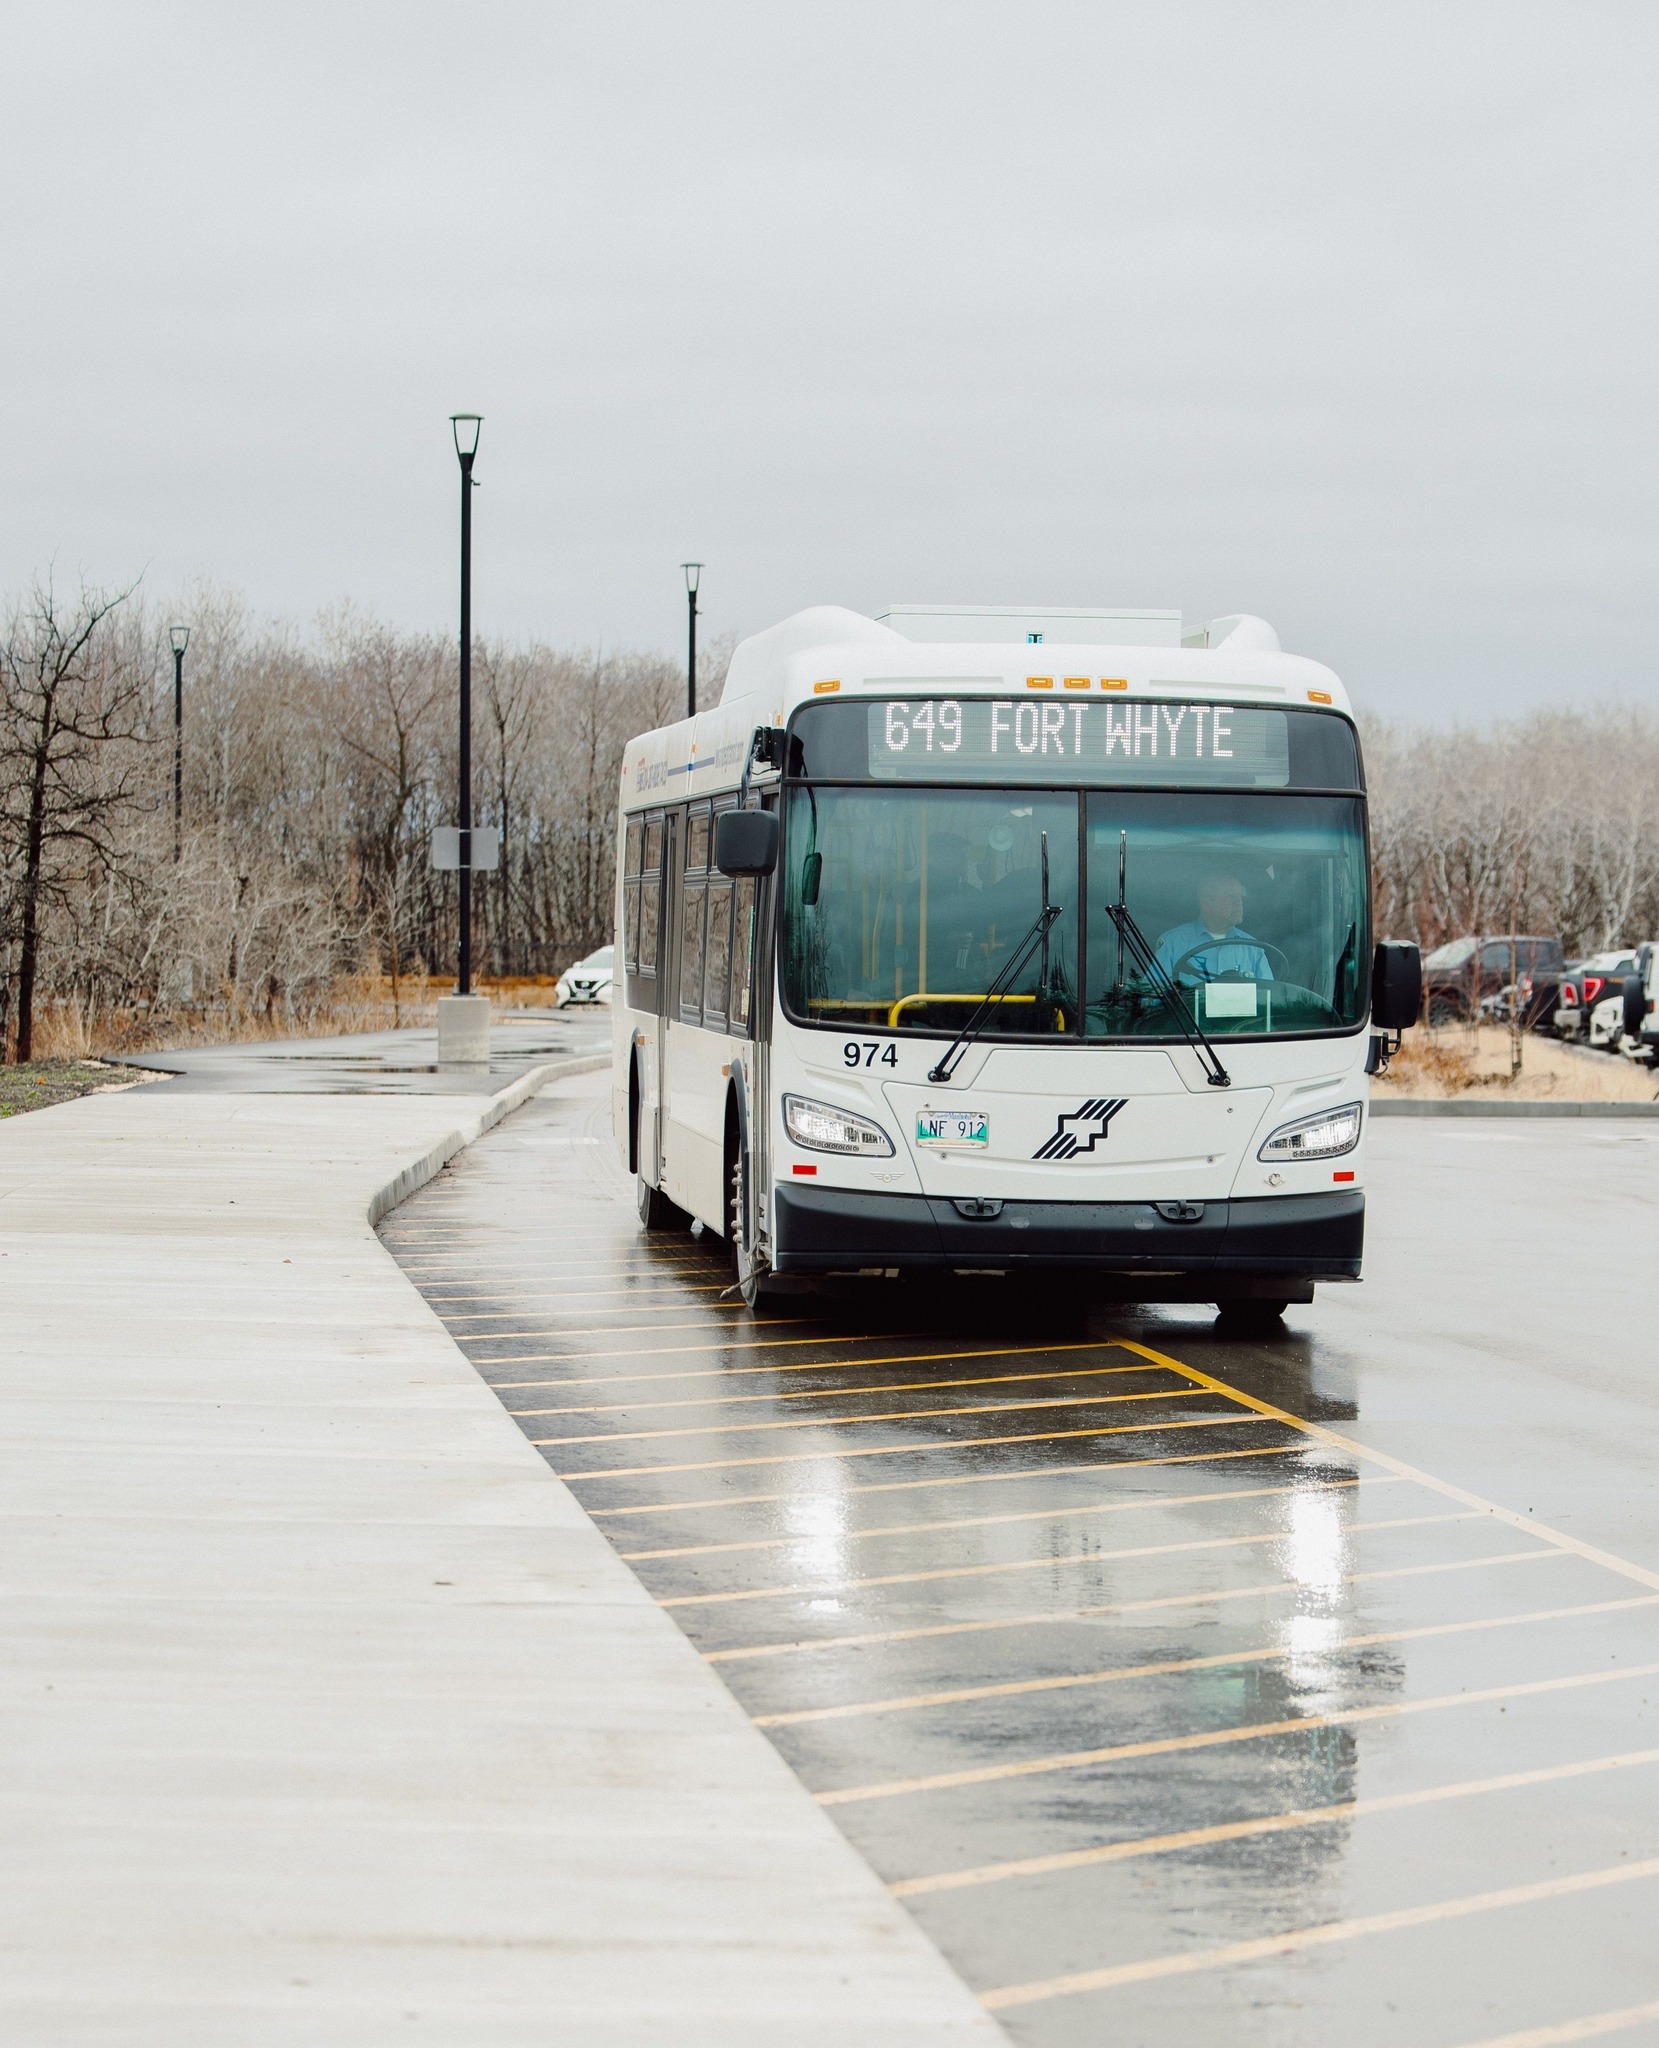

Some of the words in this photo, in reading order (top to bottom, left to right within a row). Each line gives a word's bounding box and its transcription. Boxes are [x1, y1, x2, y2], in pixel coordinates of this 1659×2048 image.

[886, 700, 962, 751] 649
[991, 701, 1089, 753] FORT
[1106, 703, 1234, 757] WHYTE
[843, 1042, 899, 1068] 974
[920, 1119, 948, 1137] LNF
[958, 1121, 985, 1138] 912
